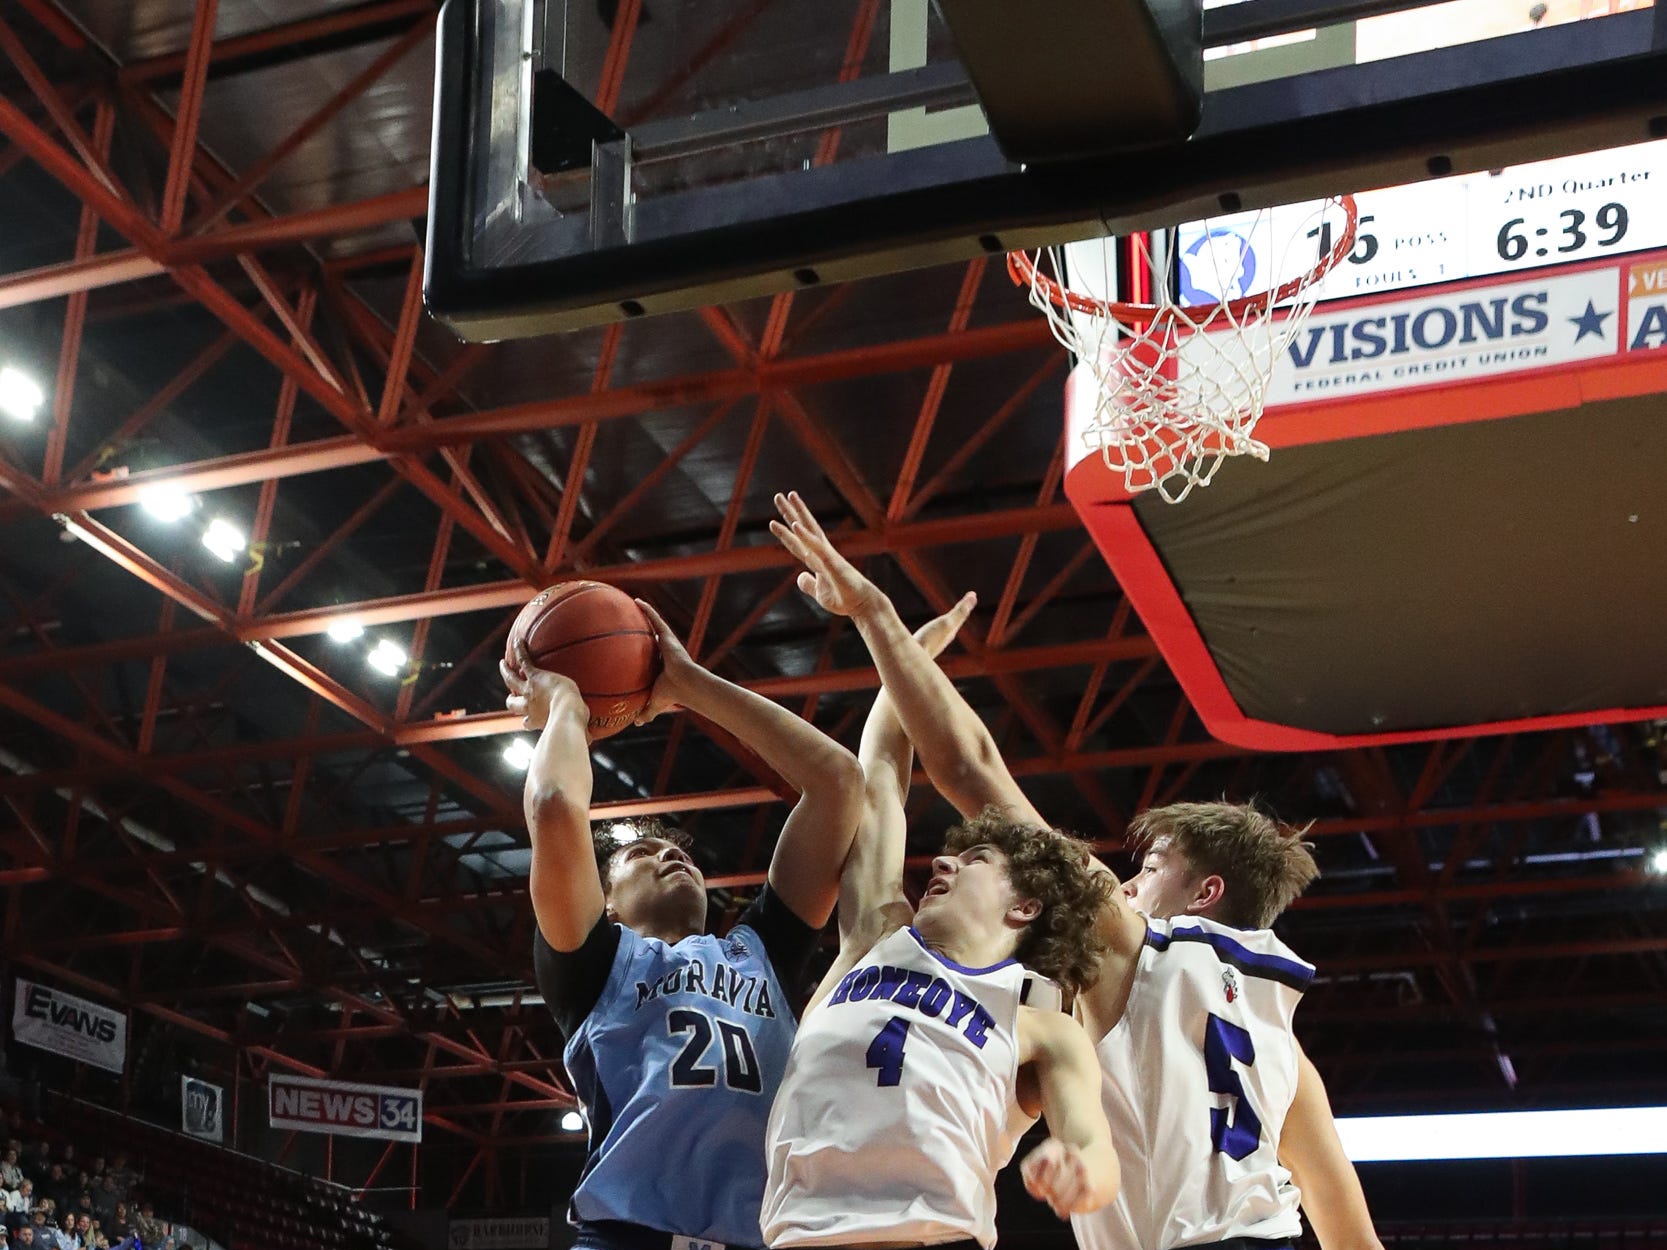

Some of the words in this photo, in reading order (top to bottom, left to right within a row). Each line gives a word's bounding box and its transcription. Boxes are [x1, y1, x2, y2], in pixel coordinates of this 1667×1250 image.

[1504, 184, 1553, 203] 2ND
[1562, 170, 1651, 194] Quarter
[1496, 202, 1629, 261] 6:39
[1288, 292, 1548, 369] VISIONS
[1294, 369, 1383, 391] FEDERAL
[1393, 357, 1468, 378] CREDIT
[1478, 346, 1548, 366] UNION
[635, 959, 776, 1019] MORAVIA
[828, 965, 997, 1050] HONEOYE
[667, 1006, 763, 1095] 20
[866, 1015, 911, 1088] 4
[275, 1087, 375, 1125] NEWS
[381, 1099, 416, 1130] 34
[1204, 1012, 1263, 1162] 5
